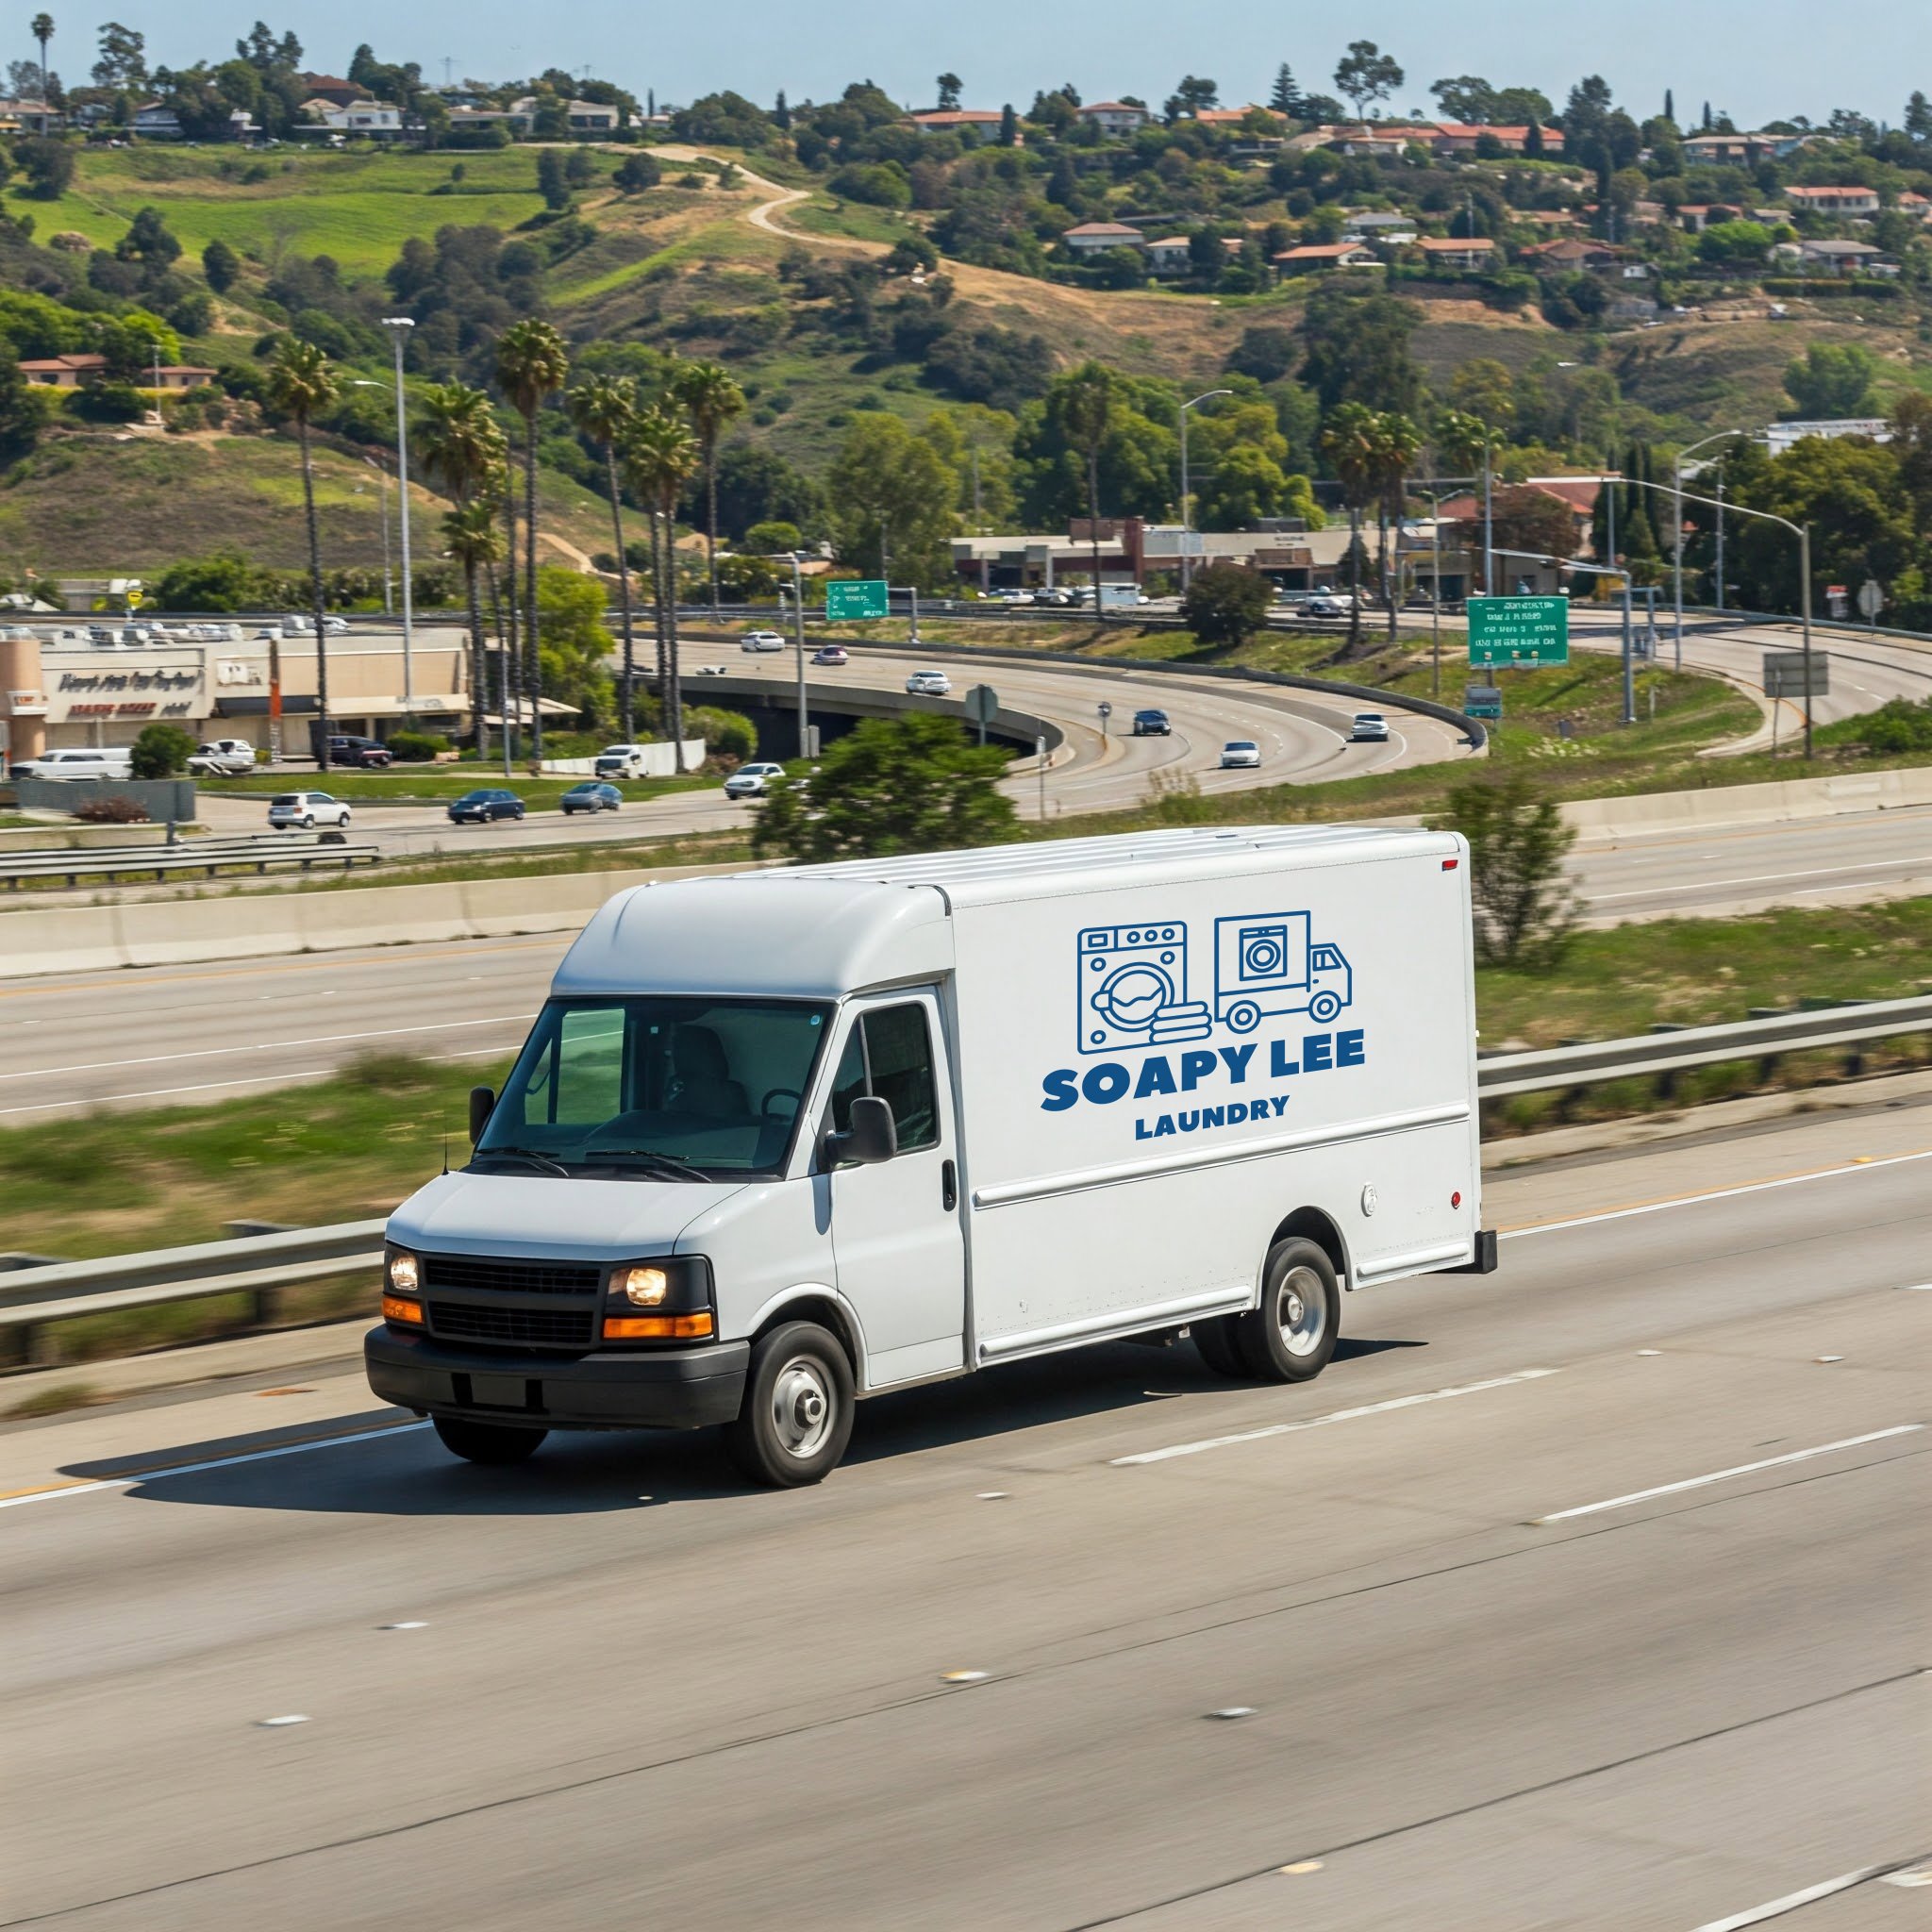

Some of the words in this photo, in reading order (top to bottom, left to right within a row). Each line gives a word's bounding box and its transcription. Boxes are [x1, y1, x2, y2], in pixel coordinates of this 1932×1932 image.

[1041, 1042, 1258, 1112] SOAPY
[1270, 1028, 1366, 1078] LEE
[1134, 1094, 1291, 1141] LAUNDRY
